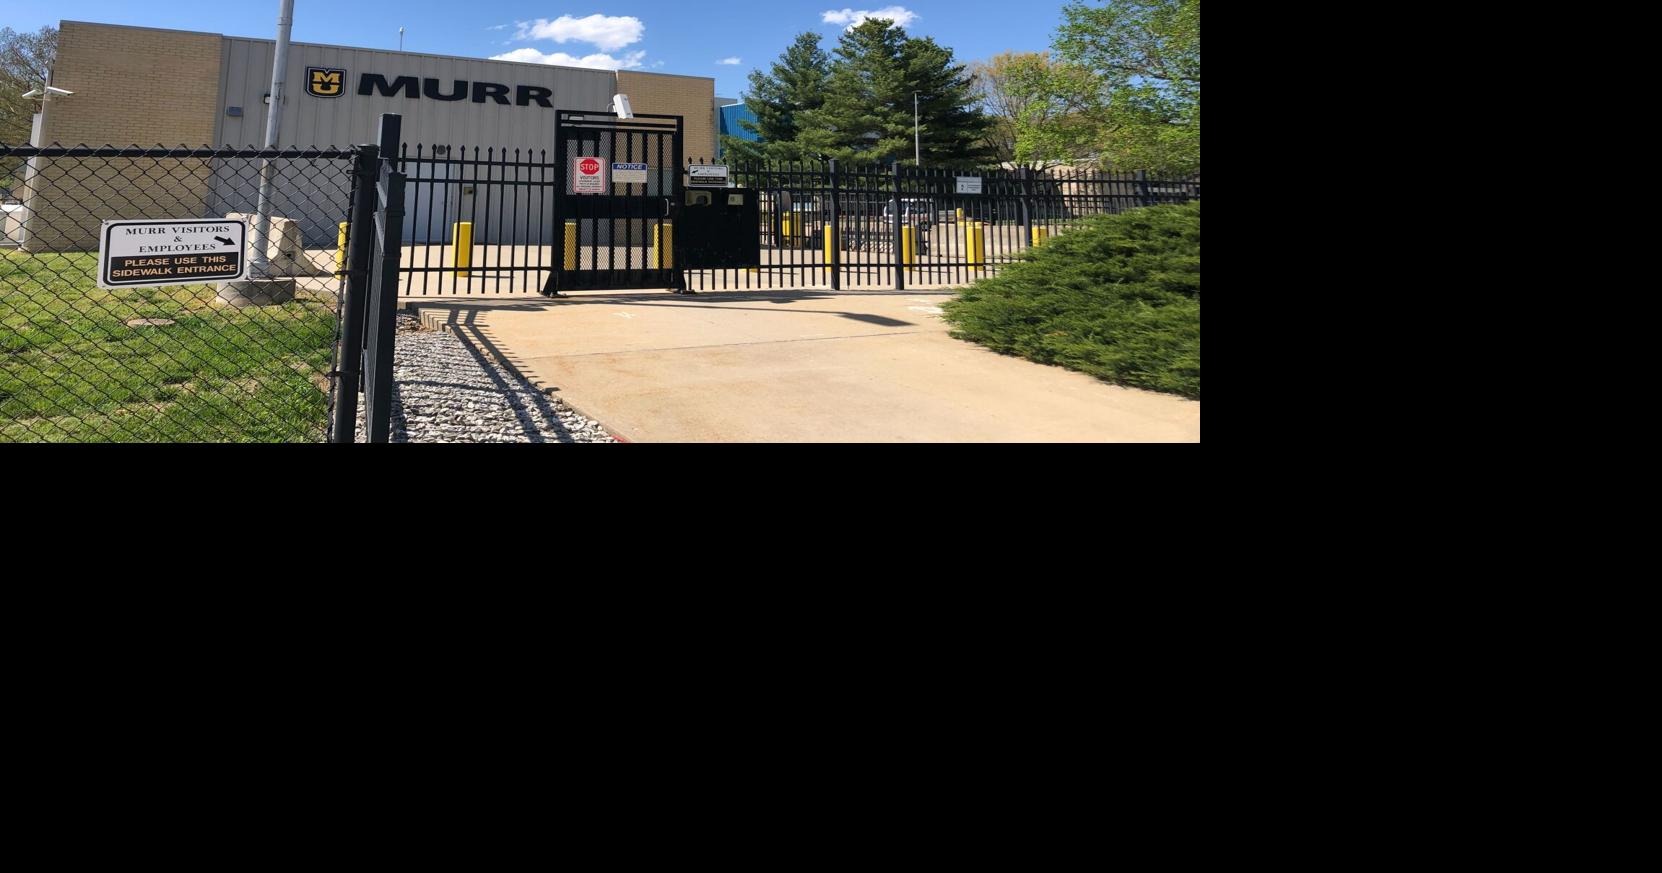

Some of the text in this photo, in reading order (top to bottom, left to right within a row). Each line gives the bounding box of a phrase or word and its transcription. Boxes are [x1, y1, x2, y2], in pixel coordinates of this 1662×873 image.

[357, 73, 554, 108] MURR
[580, 163, 599, 171] STOP
[126, 225, 230, 235] MURR VISITORS
[173, 235, 183, 243] &
[139, 243, 216, 253] EMPLOYEES
[124, 255, 227, 267] PLEASE USE THIS
[112, 264, 237, 277] SIDEWALK ENTRANCE
